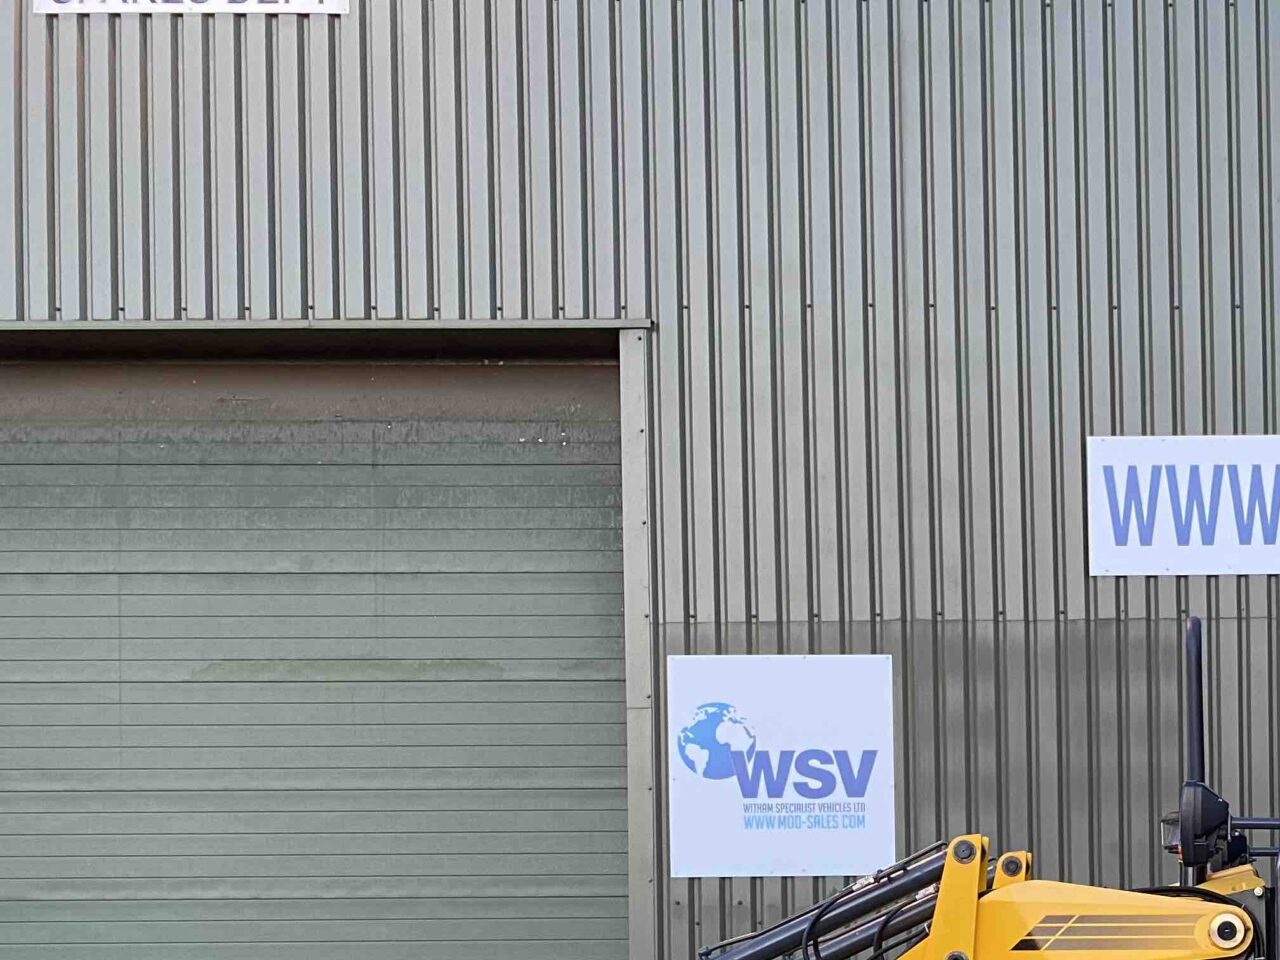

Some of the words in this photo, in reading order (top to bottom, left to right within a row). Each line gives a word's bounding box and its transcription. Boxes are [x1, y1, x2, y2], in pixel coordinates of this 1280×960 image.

[730, 748, 879, 799] WSV
[743, 802, 774, 814] WITHAM
[775, 802, 817, 814] SPECIALIST
[818, 801, 852, 813] VEHICLES
[853, 801, 866, 813] LTD
